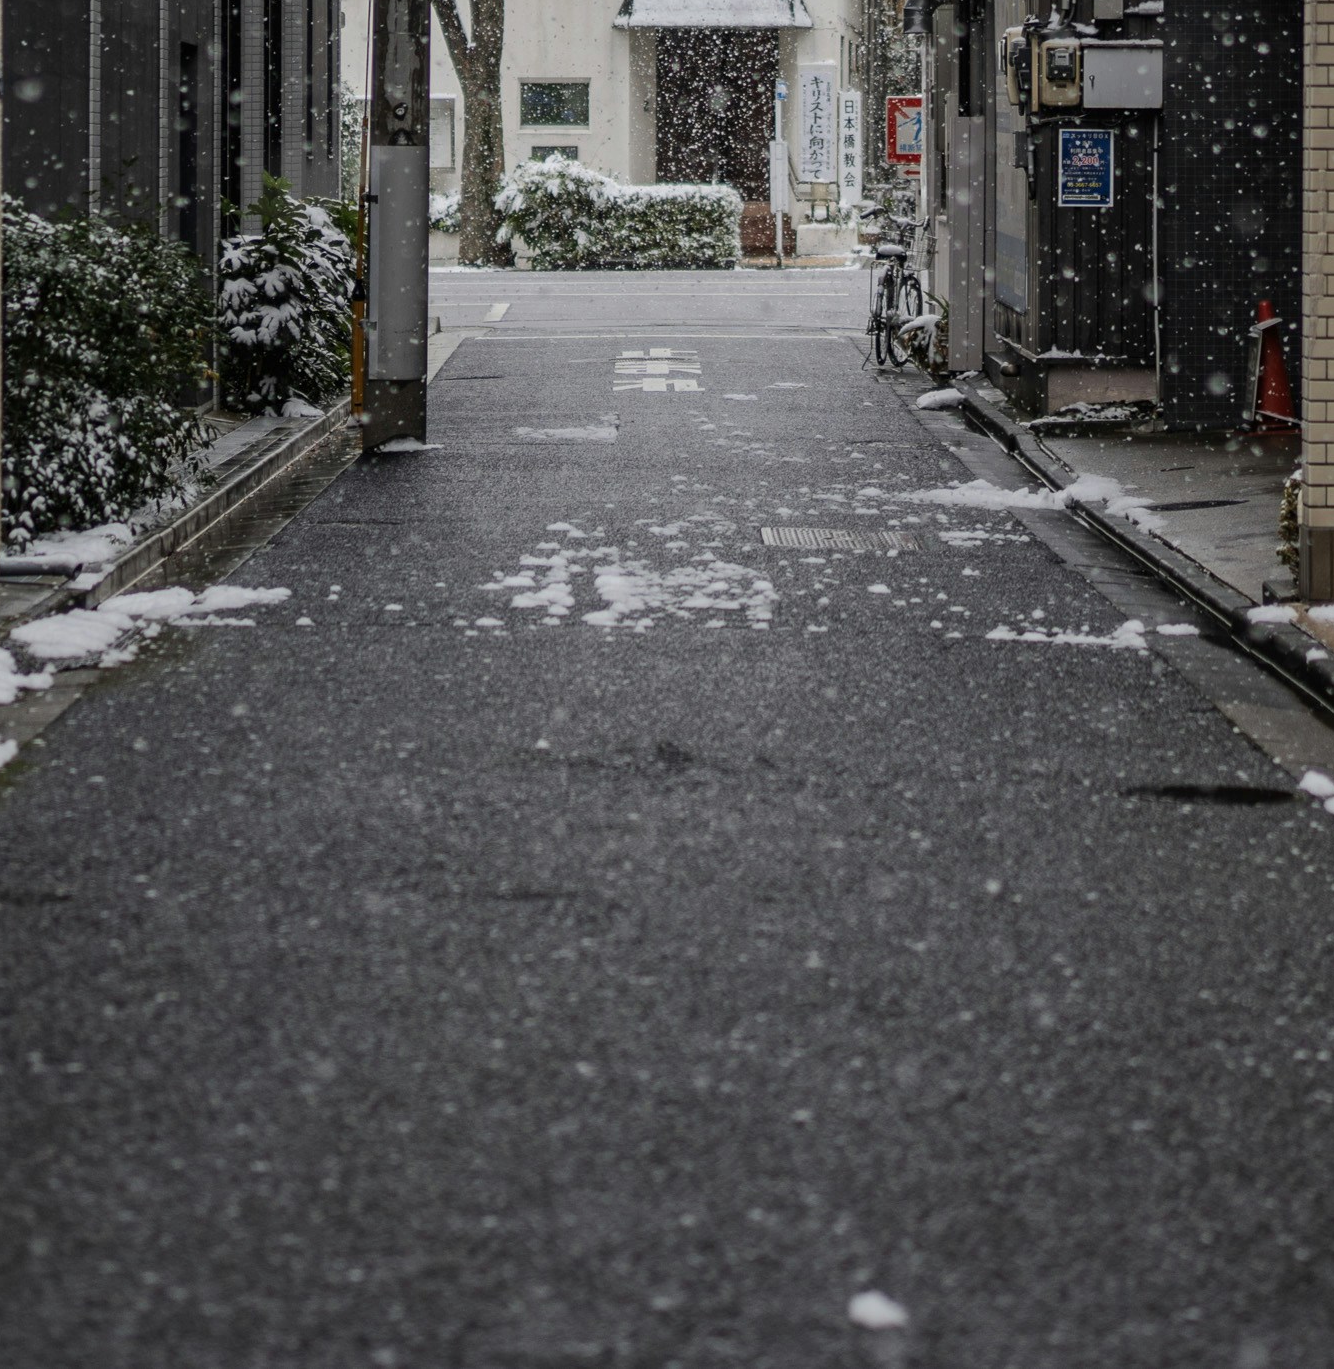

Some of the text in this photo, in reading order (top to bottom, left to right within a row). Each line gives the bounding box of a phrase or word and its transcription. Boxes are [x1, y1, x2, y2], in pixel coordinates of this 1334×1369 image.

[843, 100, 856, 188] 日本橋教会
